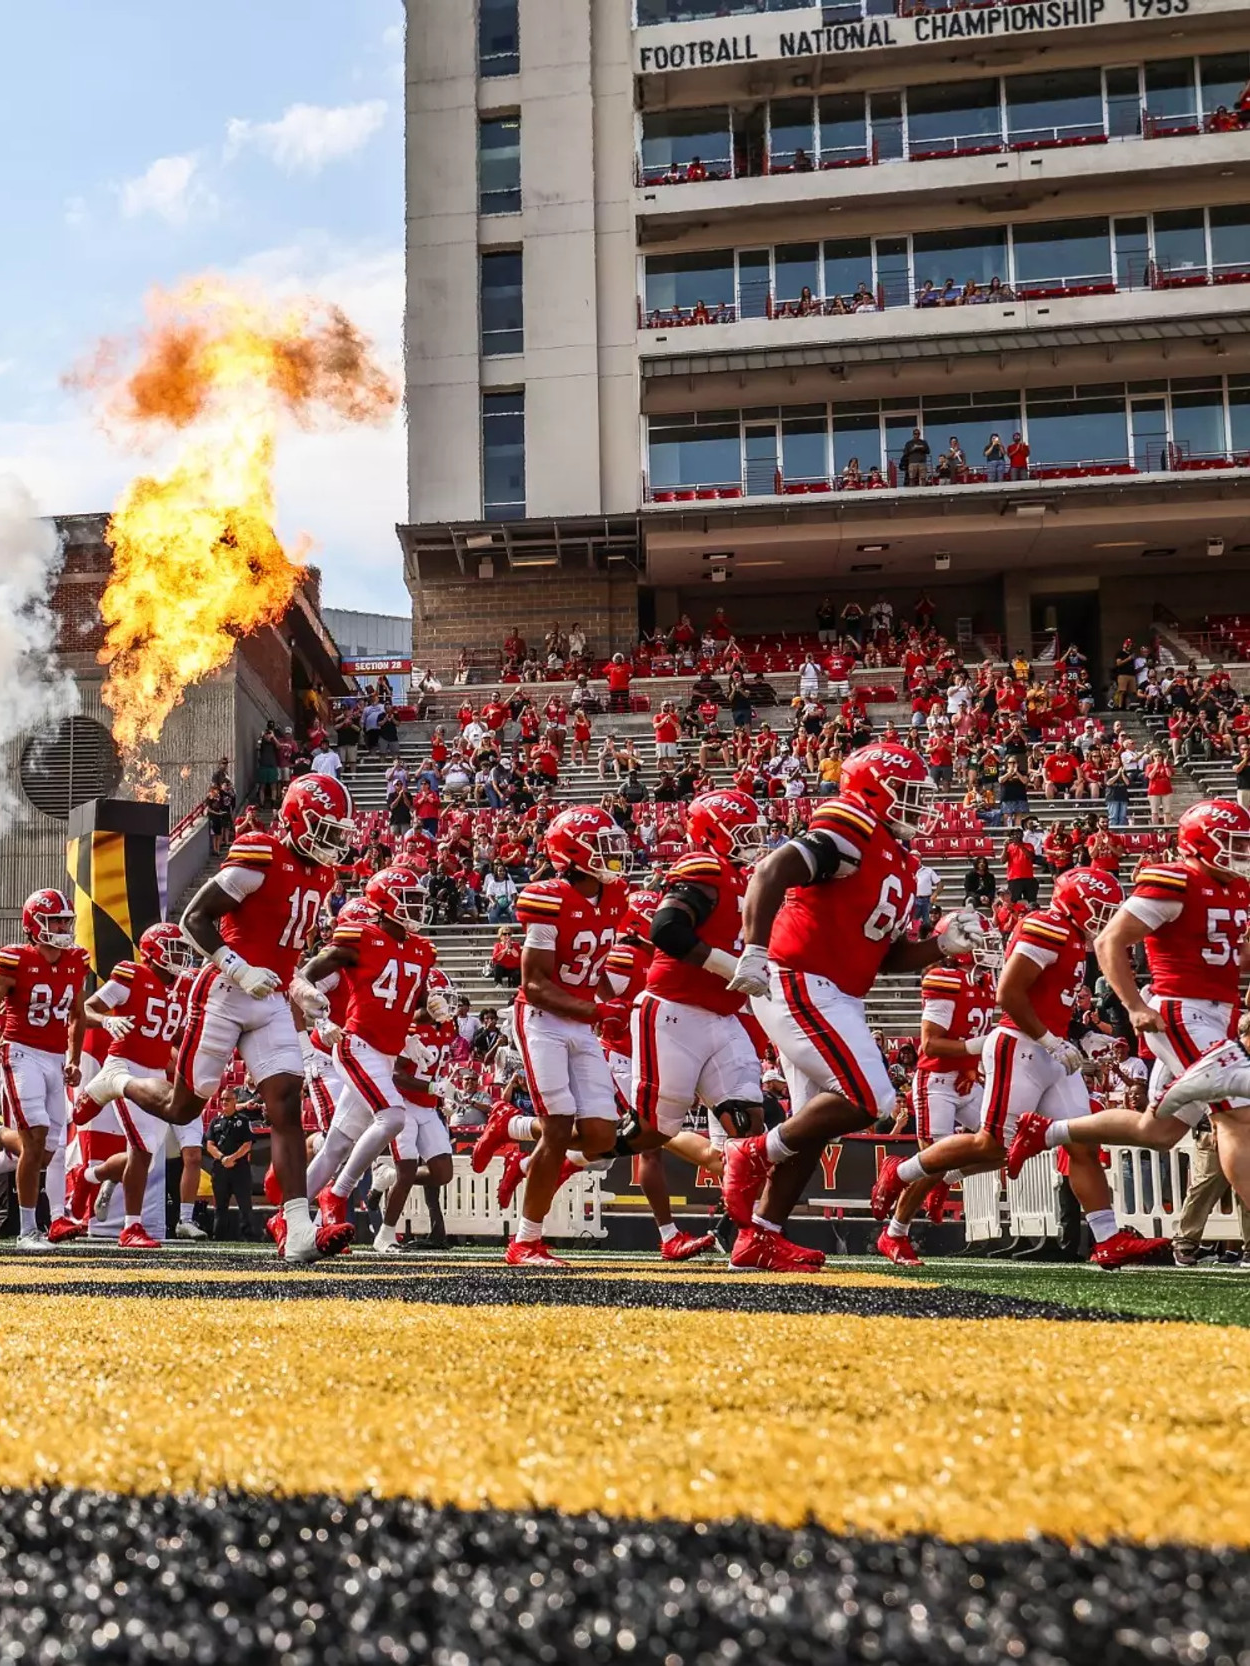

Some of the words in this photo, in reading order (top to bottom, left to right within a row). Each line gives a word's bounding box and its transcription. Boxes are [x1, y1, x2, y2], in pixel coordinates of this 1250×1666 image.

[640, 34, 758, 70] FOOTBALL
[779, 20, 897, 56] NATIONAL
[915, 0, 1104, 41] CHAMPIONSHIP
[354, 661, 389, 671] SECTION
[392, 661, 402, 670] 28
[863, 748, 912, 769] Terps
[295, 779, 336, 810] Terps
[702, 795, 745, 815] Terps
[1075, 871, 1112, 895] Terps
[279, 886, 321, 950] 10
[27, 983, 75, 1028] 84
[371, 958, 423, 1015] 47
[140, 997, 183, 1042] 58
